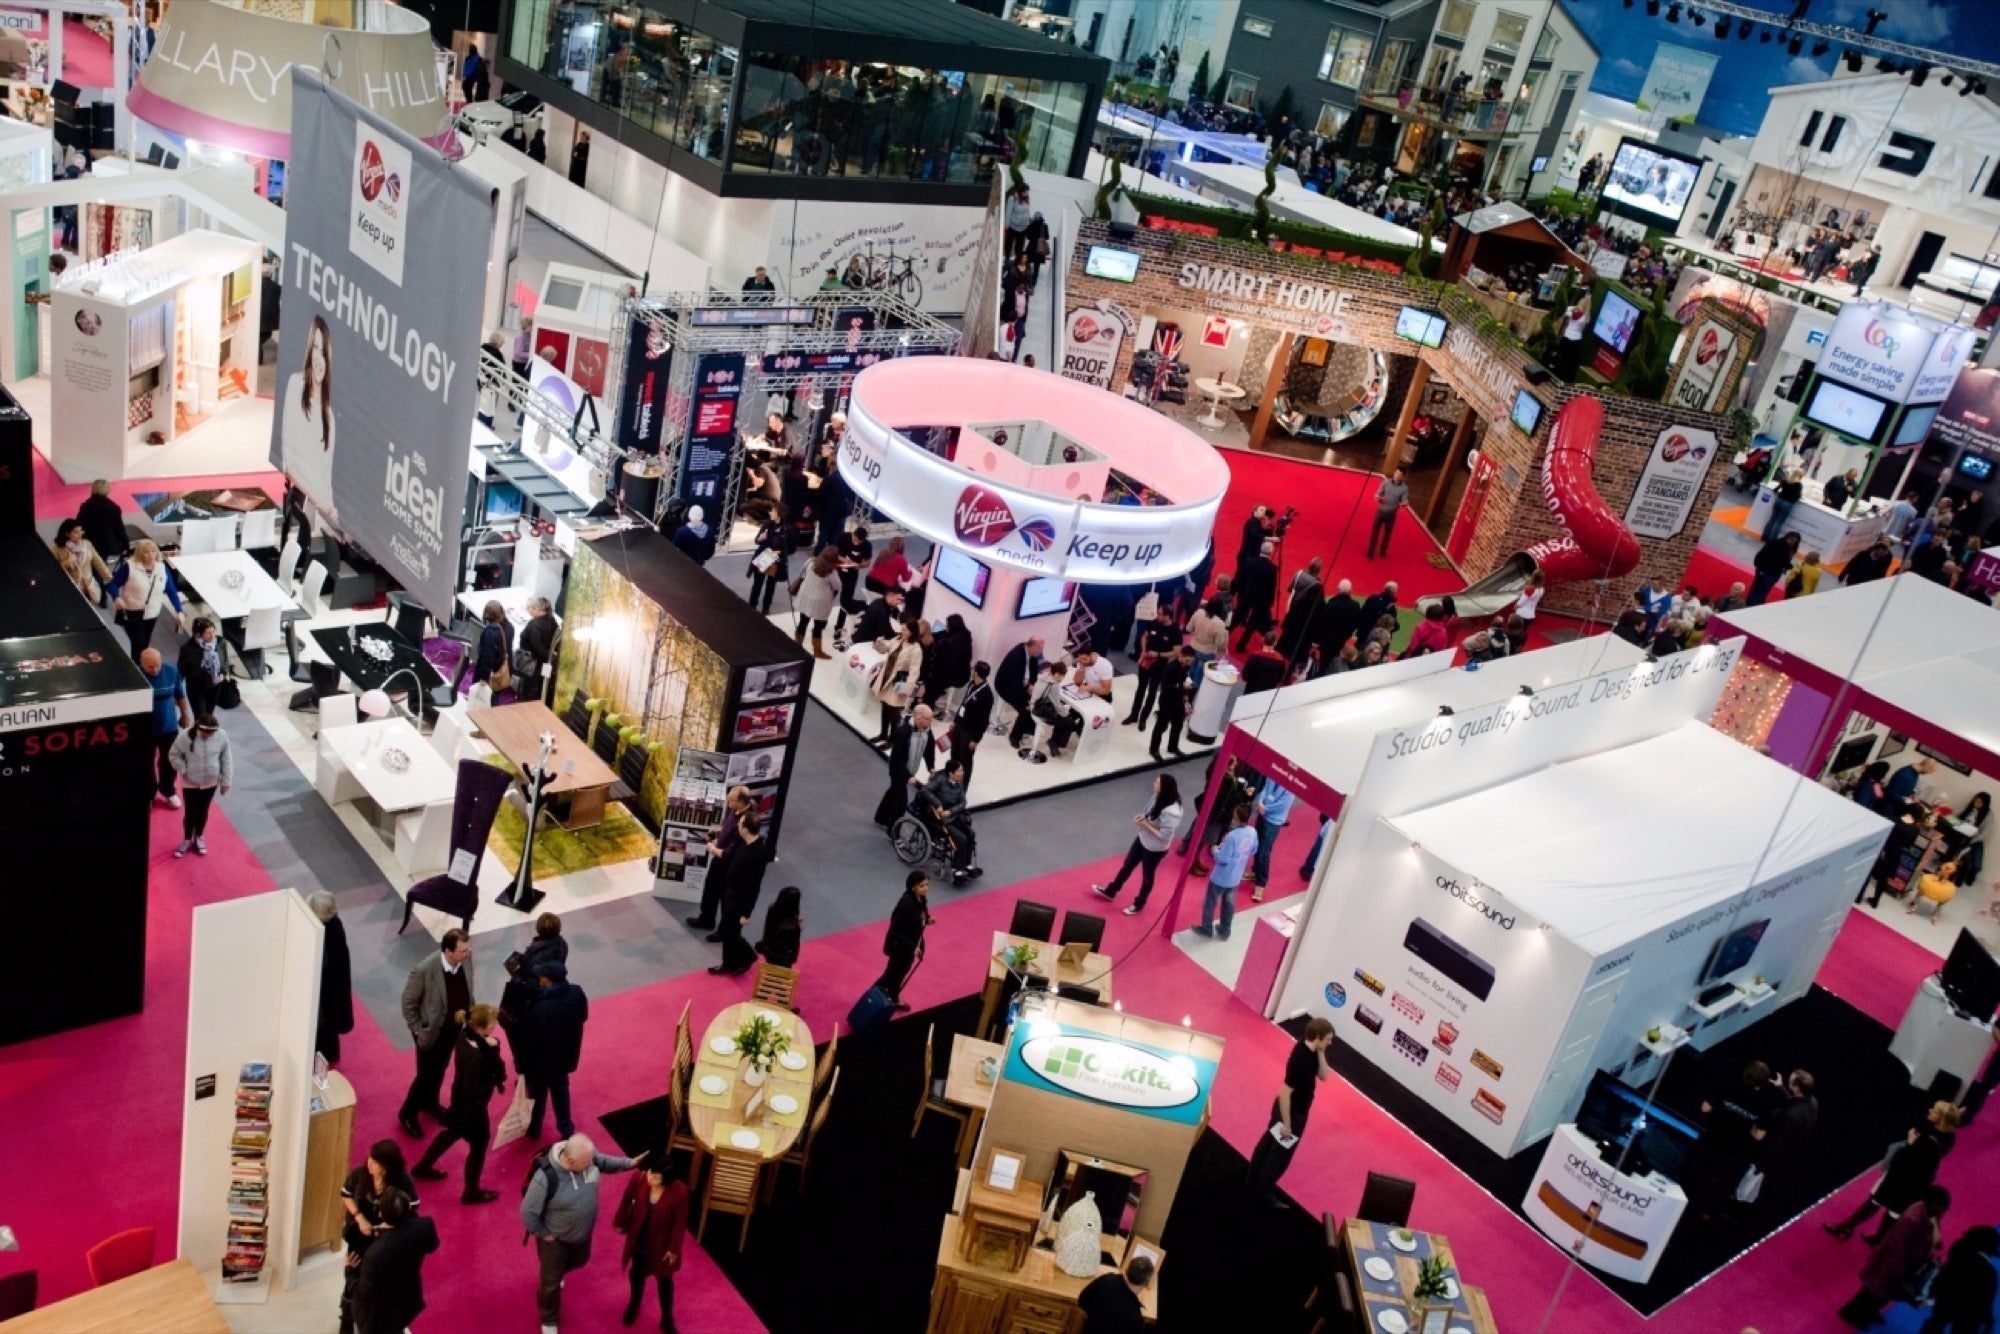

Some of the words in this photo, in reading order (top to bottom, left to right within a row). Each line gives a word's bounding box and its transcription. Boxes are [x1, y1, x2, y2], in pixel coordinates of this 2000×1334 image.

[0, 15, 33, 29] ani
[157, 24, 319, 103] LLARY
[358, 211, 380, 241] Keep
[382, 231, 394, 251] up
[834, 232, 855, 247] Quiet
[858, 222, 904, 237] Revolution
[1178, 262, 1273, 300] SMART
[1273, 277, 1353, 317] HOME
[291, 242, 456, 404] TECHNOLOGY
[1064, 355, 1108, 374] ROOF
[1829, 361, 1859, 377] made
[1860, 372, 1896, 391] simple
[1832, 347, 1869, 369] Energy
[1871, 362, 1904, 383] saving
[863, 455, 881, 482] up
[386, 442, 443, 541] ideal
[1645, 485, 1690, 501] STANDARD
[384, 493, 413, 529] HOME
[413, 520, 442, 555] SHOW
[957, 491, 1012, 541] Virgin
[996, 547, 1044, 568] media
[1067, 534, 1129, 565] Keep
[1134, 541, 1162, 565] up
[0, 707, 56, 727] ALIANI
[1387, 726, 1452, 760] Studio
[1458, 704, 1520, 746] quality
[1523, 688, 1581, 721] Sound.
[1590, 663, 1665, 703] Designed
[1662, 657, 1694, 685] for
[1691, 647, 1735, 675] Living
[24, 722, 129, 757] SOFAS
[1436, 875, 1515, 930] orbitsound
[1408, 965, 1430, 984] audio
[1431, 976, 1445, 993] for
[1446, 985, 1469, 1012] living
[1563, 1161, 1594, 1192] BELIEVE
[1619, 1199, 1646, 1217] EARS
[1567, 1153, 1650, 1209] orbitsound
